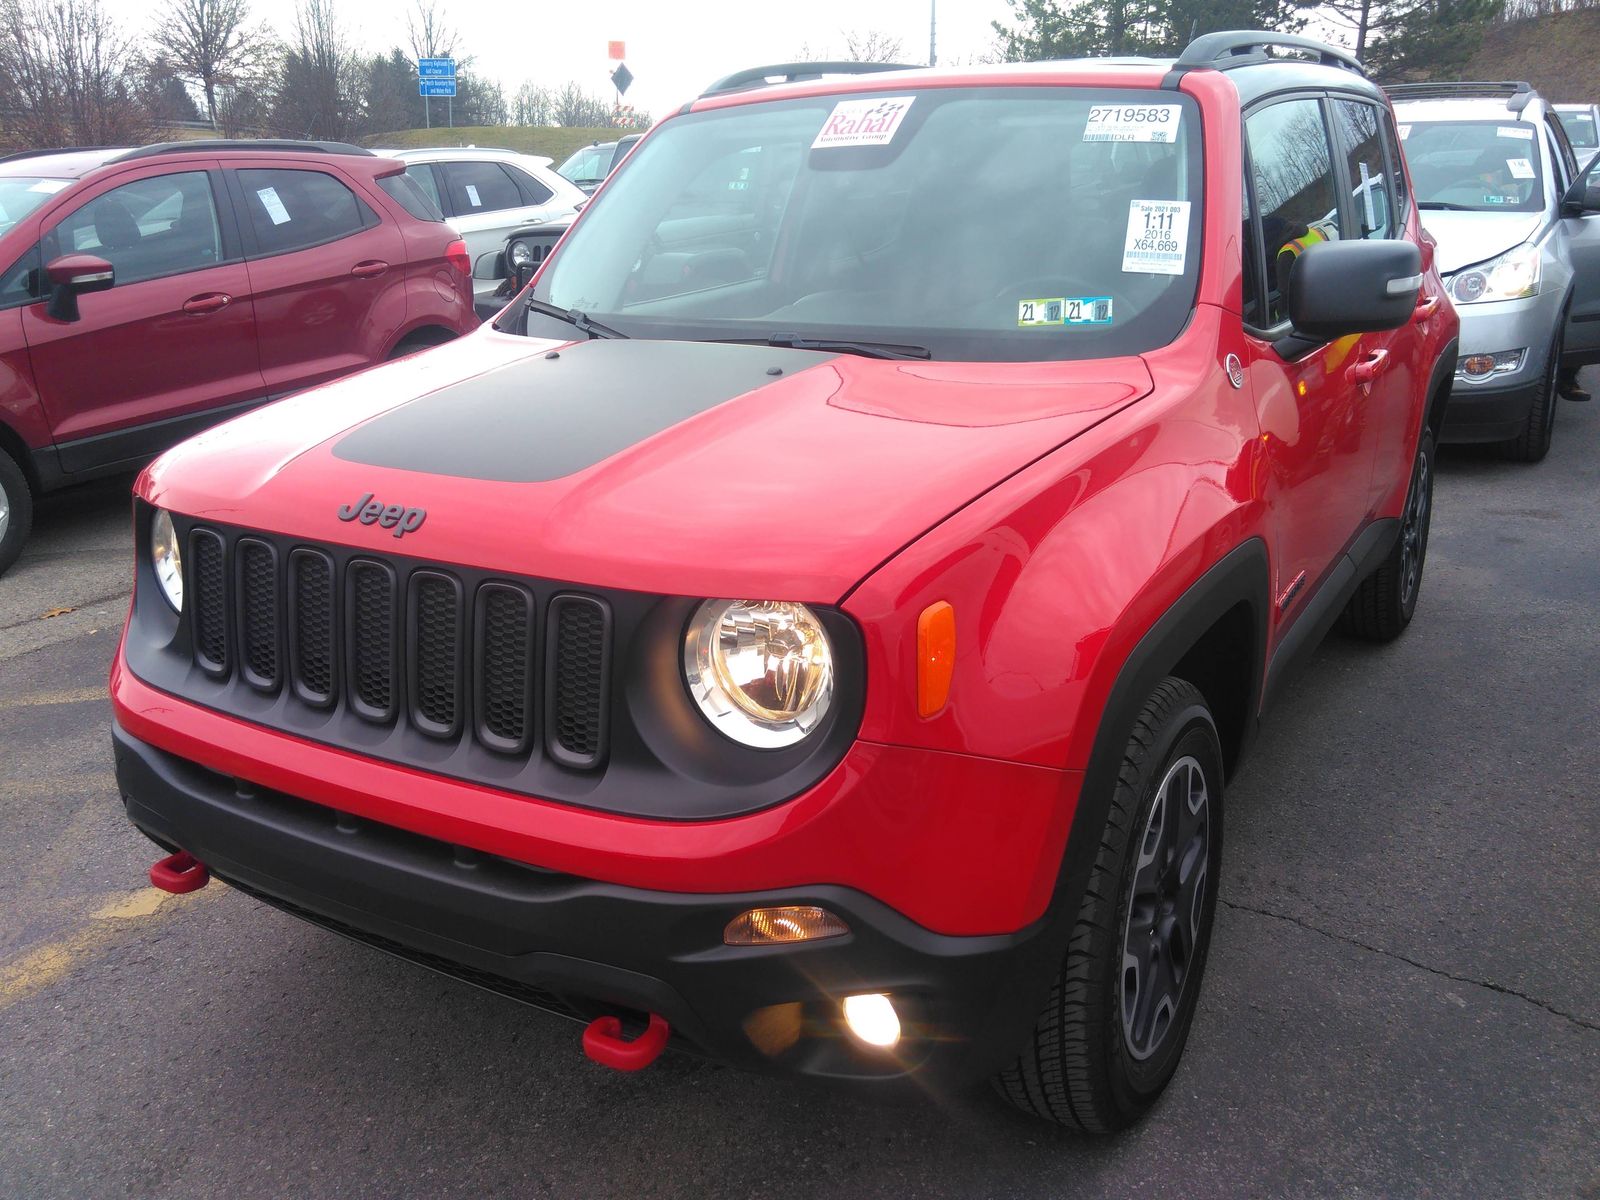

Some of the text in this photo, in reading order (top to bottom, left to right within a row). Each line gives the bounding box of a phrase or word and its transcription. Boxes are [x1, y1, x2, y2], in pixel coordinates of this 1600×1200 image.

[823, 111, 899, 136] Rahal
[1088, 108, 1171, 123] 2719583
[1144, 212, 1173, 230] 1:11
[1144, 229, 1171, 240] 2016
[1022, 303, 1060, 321] 21 12
[1069, 301, 1108, 320] 21 12
[336, 491, 427, 539] Jeep
